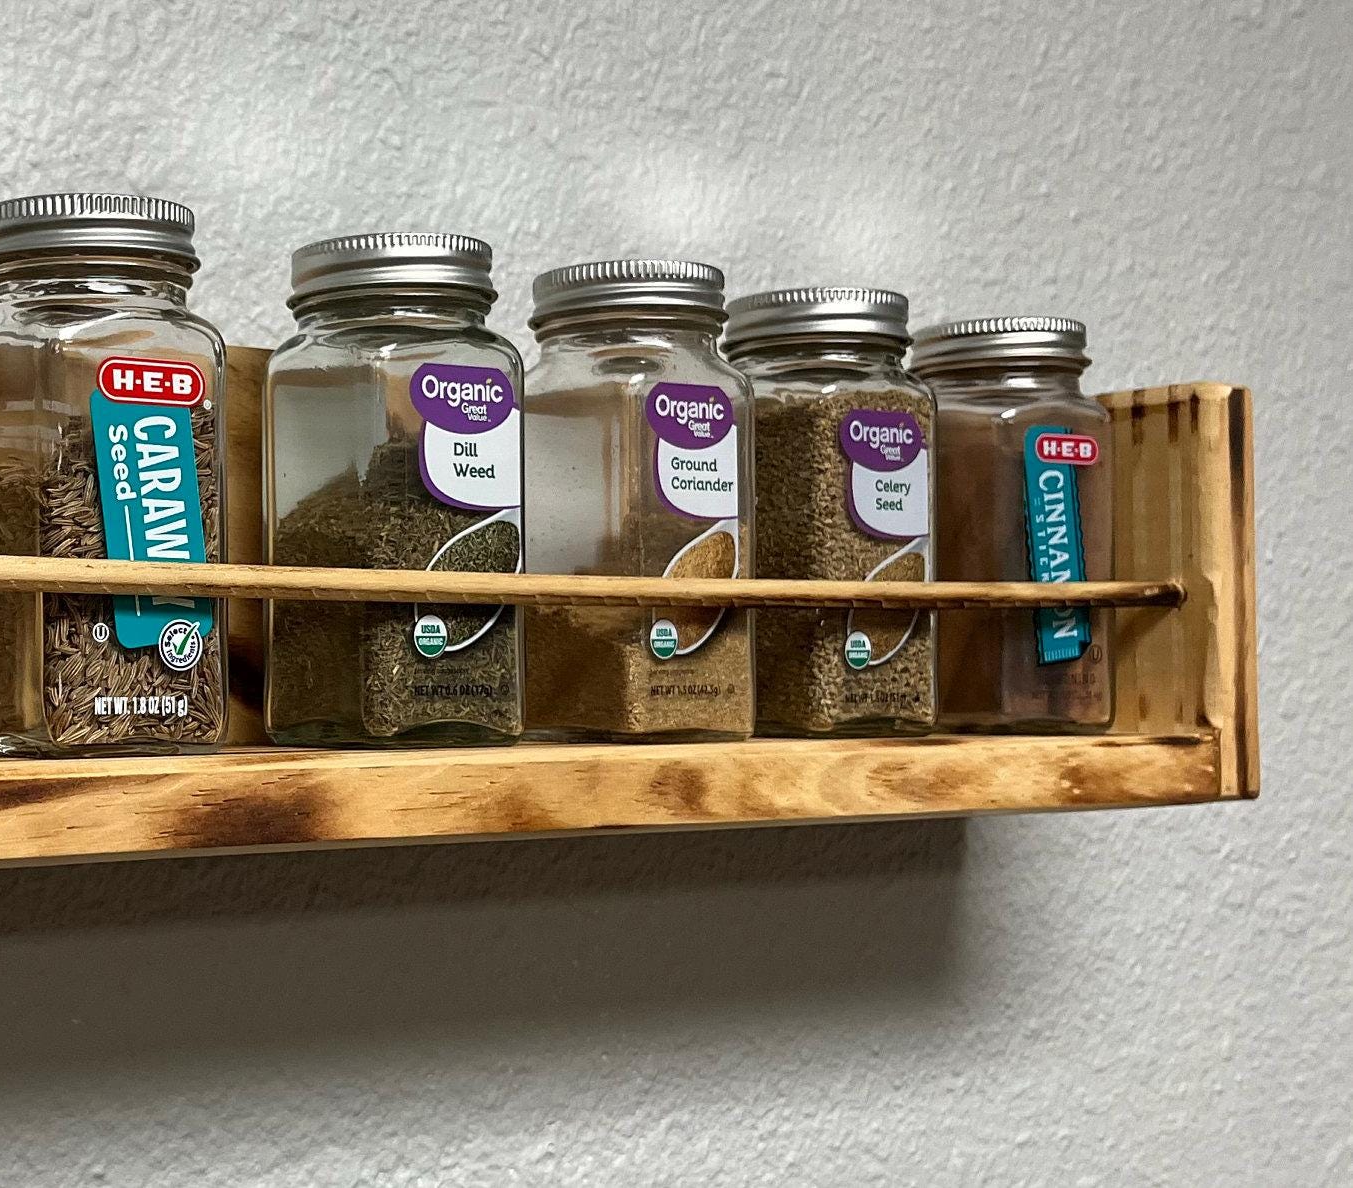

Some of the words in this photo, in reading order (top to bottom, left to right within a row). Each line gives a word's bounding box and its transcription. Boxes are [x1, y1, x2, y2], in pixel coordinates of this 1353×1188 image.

[422, 375, 503, 407] Organic
[461, 402, 487, 415] Great
[655, 394, 724, 424] Organic
[688, 420, 710, 432] Great
[850, 420, 914, 449] Organic
[453, 441, 478, 457] Dill
[880, 444, 901, 455] Great
[453, 463, 495, 479] Weed
[671, 457, 718, 472] Ground
[671, 476, 734, 492] Coriander
[875, 479, 911, 496] Celery
[133, 415, 195, 609] CARAWY
[875, 498, 903, 511] Seed
[421, 624, 441, 634] USDA
[94, 697, 112, 715] NET
[114, 697, 131, 715] WT.
[132, 697, 147, 715] 1.8
[148, 696, 159, 714] OZ
